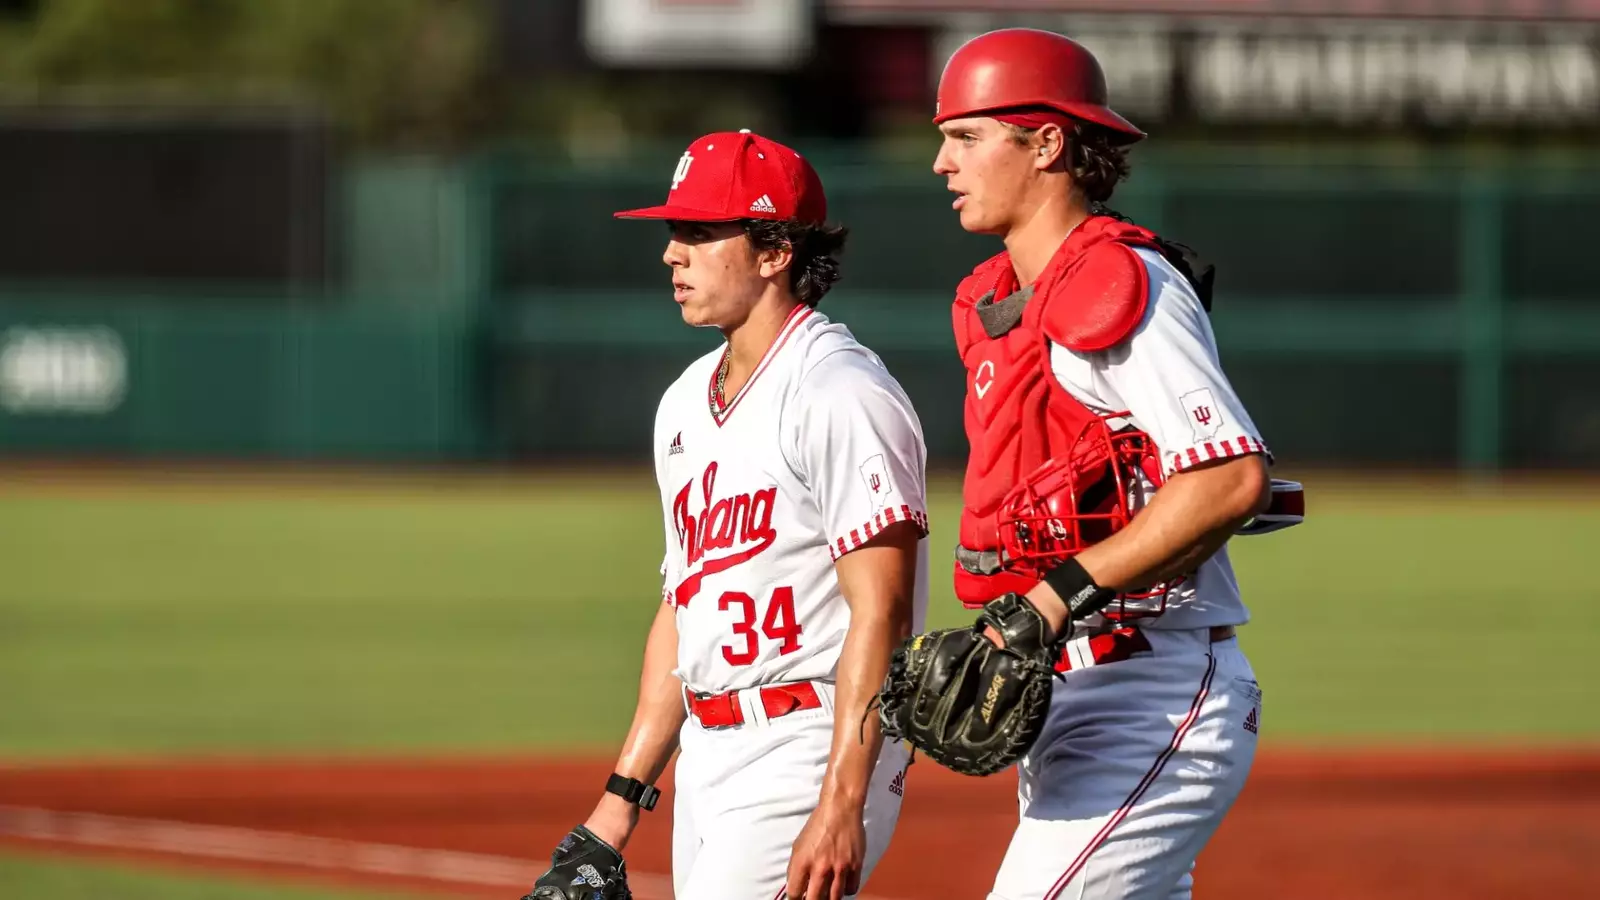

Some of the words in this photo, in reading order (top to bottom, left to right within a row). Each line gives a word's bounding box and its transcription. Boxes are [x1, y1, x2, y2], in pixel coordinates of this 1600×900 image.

[750, 205, 776, 214] adidas
[673, 461, 777, 567] Indana
[718, 586, 803, 666] 34
